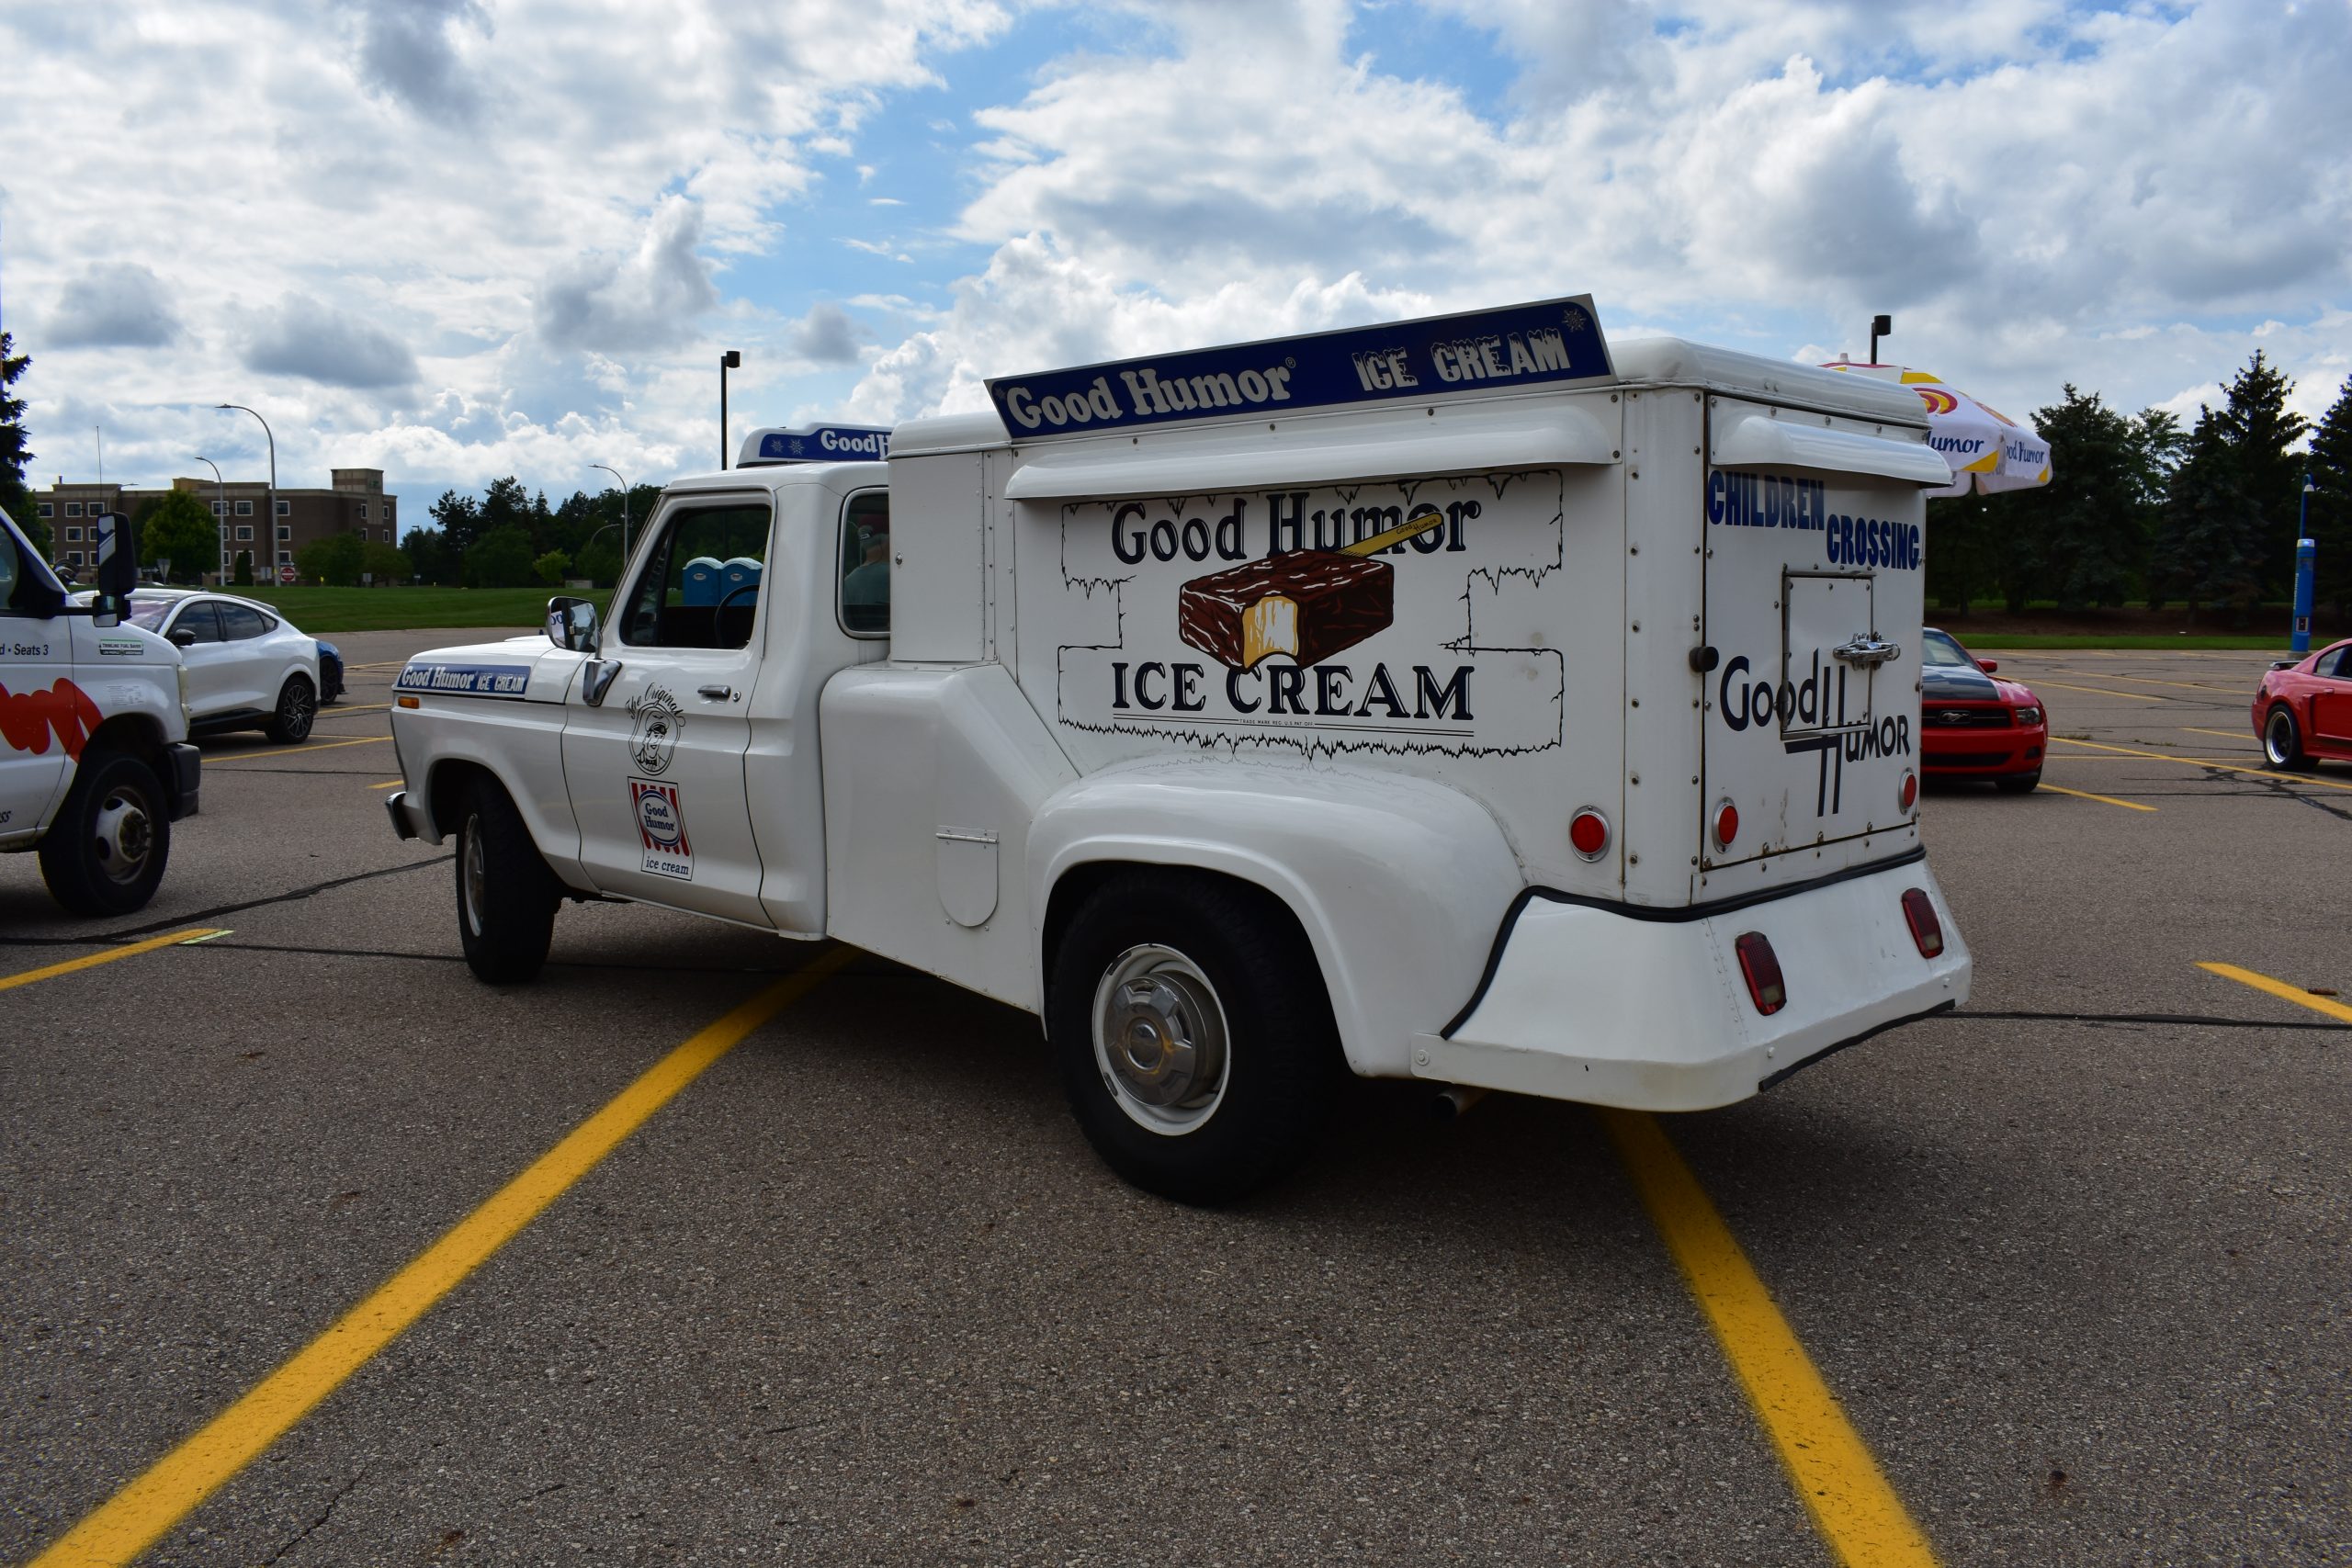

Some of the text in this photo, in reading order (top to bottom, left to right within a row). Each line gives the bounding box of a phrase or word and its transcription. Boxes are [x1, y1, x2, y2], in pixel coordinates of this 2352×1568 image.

[1006, 377, 1123, 429] Good
[1351, 346, 1419, 391] ICE
[1430, 328, 1571, 382] CREAM
[820, 430, 878, 454] Good
[1707, 469, 1825, 531] CHILDREN
[1111, 491, 1482, 565] Good Humor
[1826, 513, 1920, 570] CROSSING
[14, 644, 41, 656] Seats
[43, 644, 49, 656] 3
[401, 665, 433, 688] Good
[476, 672, 493, 691] ICE
[494, 673, 526, 692] CREAM
[1111, 660, 1476, 721] ICE CREAM
[1720, 648, 1819, 732] Good
[625, 682, 686, 728] The Original
[645, 803, 669, 818] Good
[645, 855, 689, 875] ice cream
